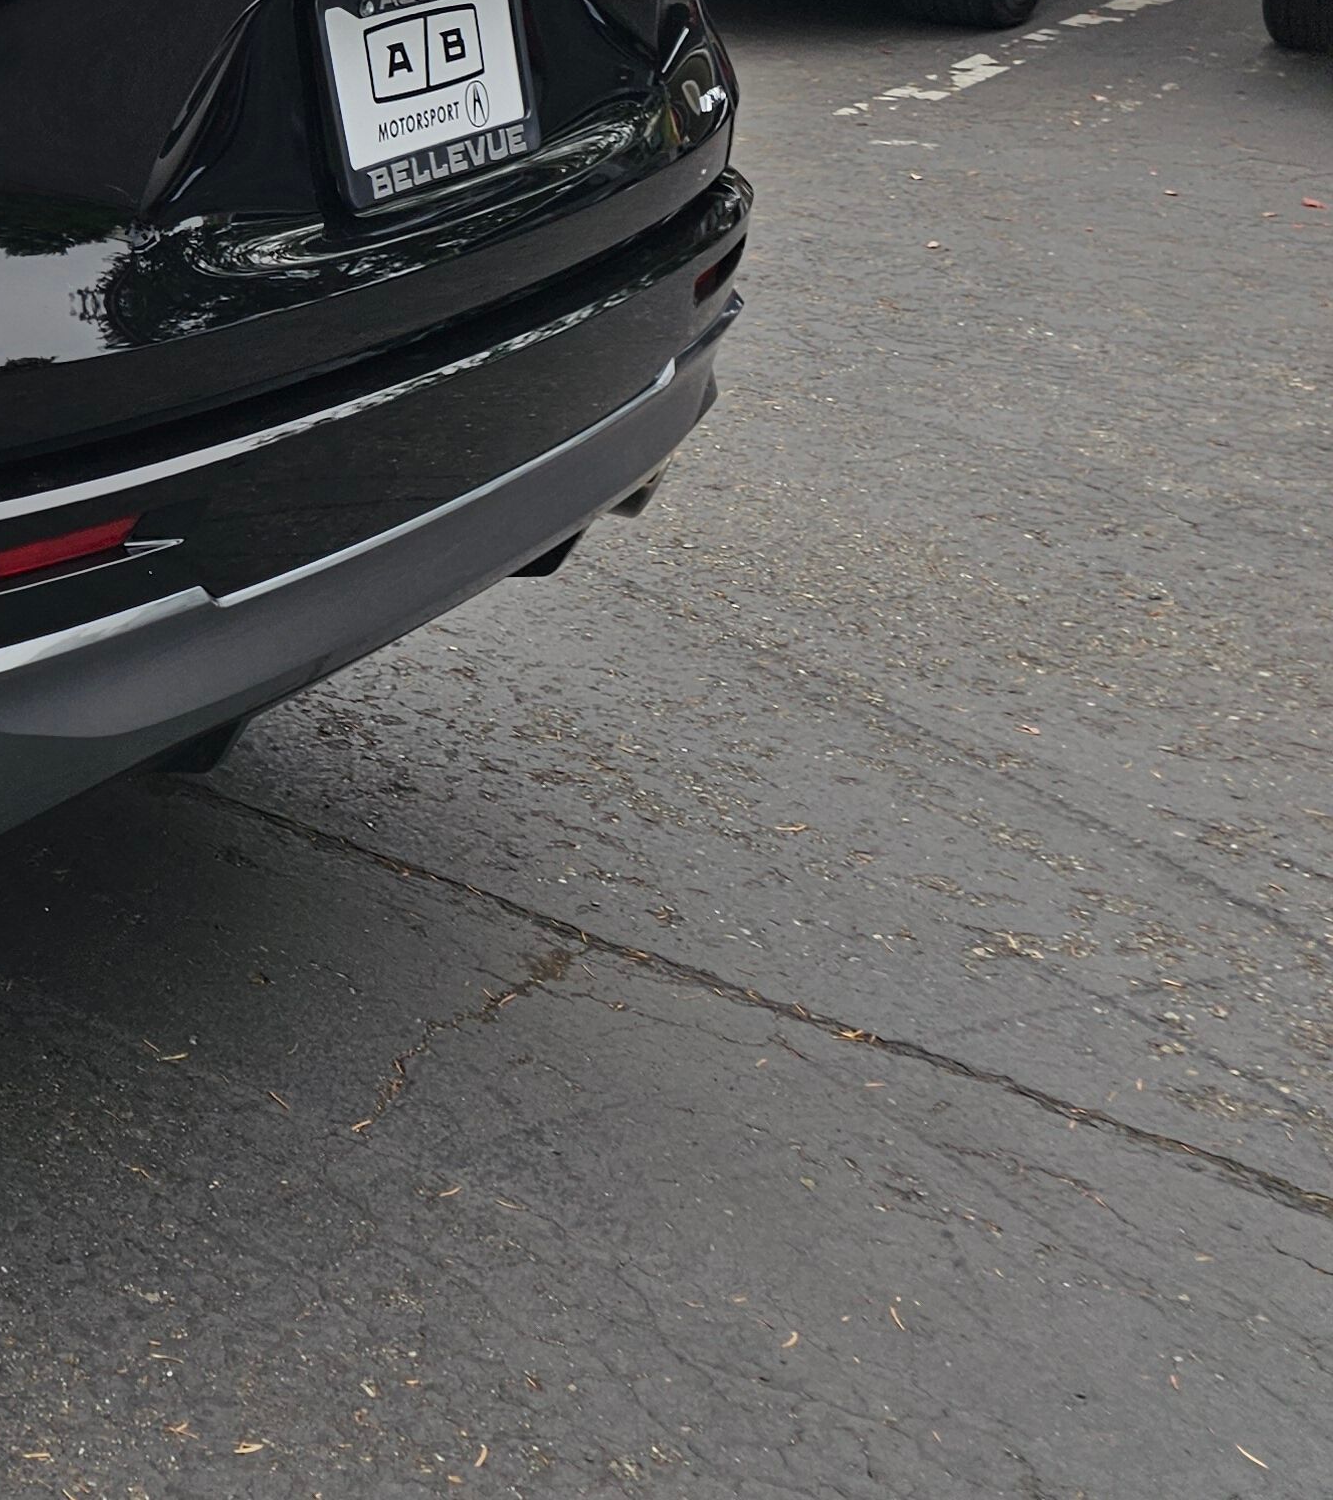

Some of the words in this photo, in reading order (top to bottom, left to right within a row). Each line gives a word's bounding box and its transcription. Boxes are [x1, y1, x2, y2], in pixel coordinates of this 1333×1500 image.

[387, 42, 413, 78] A
[439, 28, 466, 63] B
[378, 102, 459, 142] MOTORSPORT
[367, 125, 527, 199] BELLEVUE
